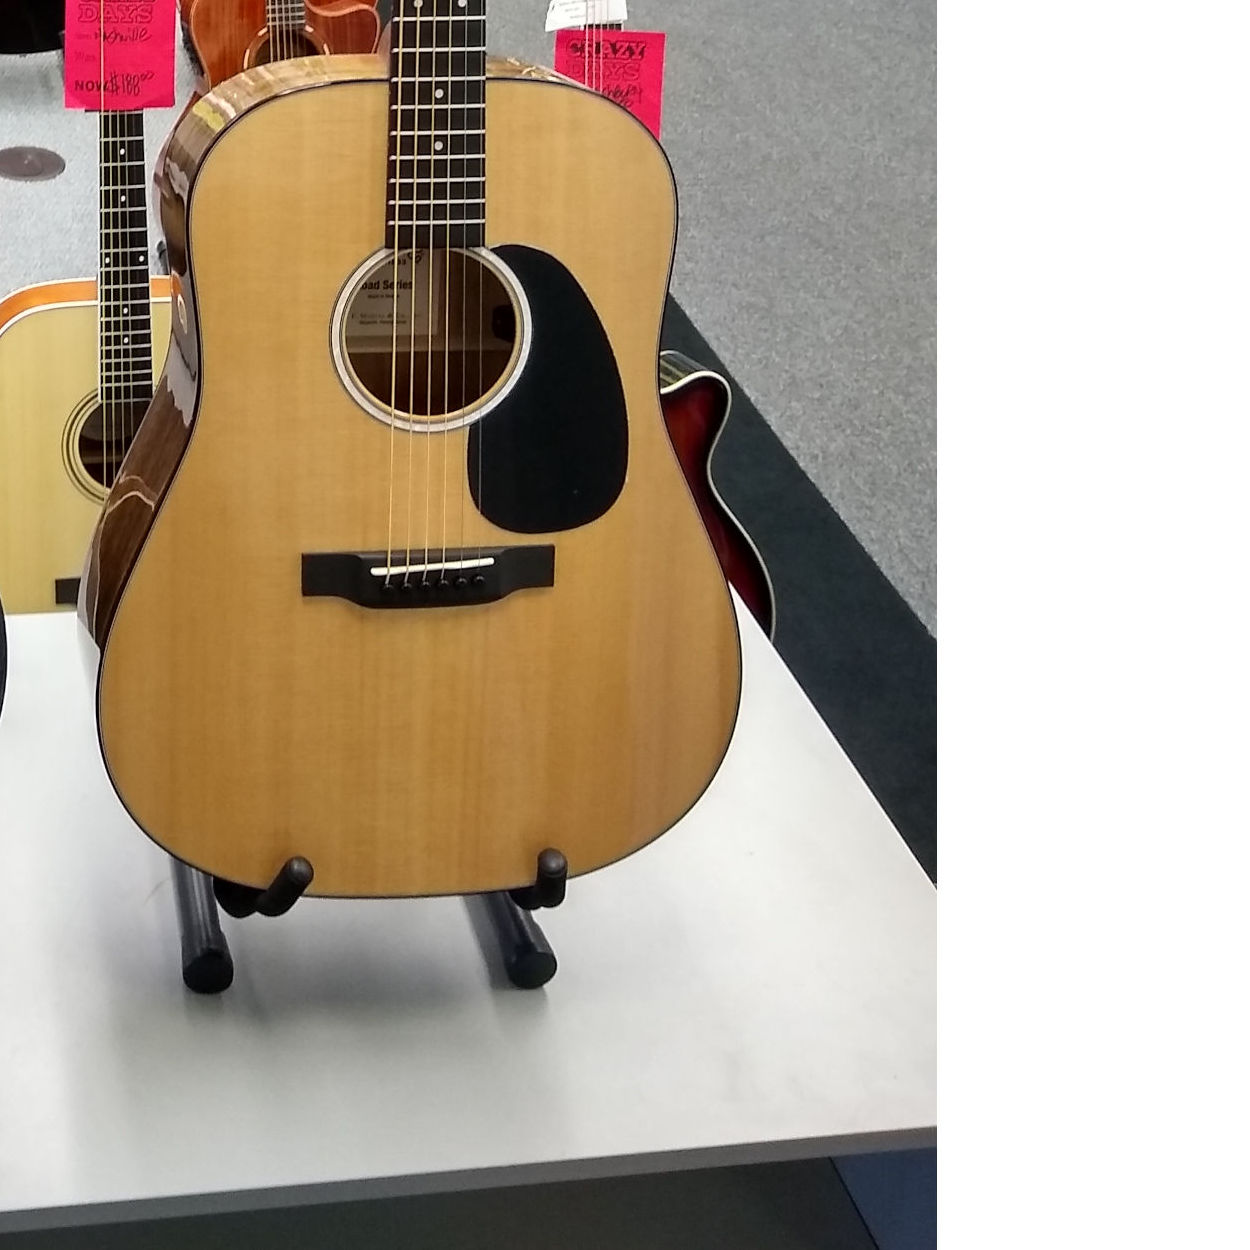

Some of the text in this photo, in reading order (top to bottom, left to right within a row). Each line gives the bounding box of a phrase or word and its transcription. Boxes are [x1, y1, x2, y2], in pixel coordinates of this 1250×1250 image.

[78, 3, 154, 24] DAYS
[566, 37, 647, 61] CRAZY
[75, 79, 109, 92] NOW
[361, 280, 380, 291] oad
